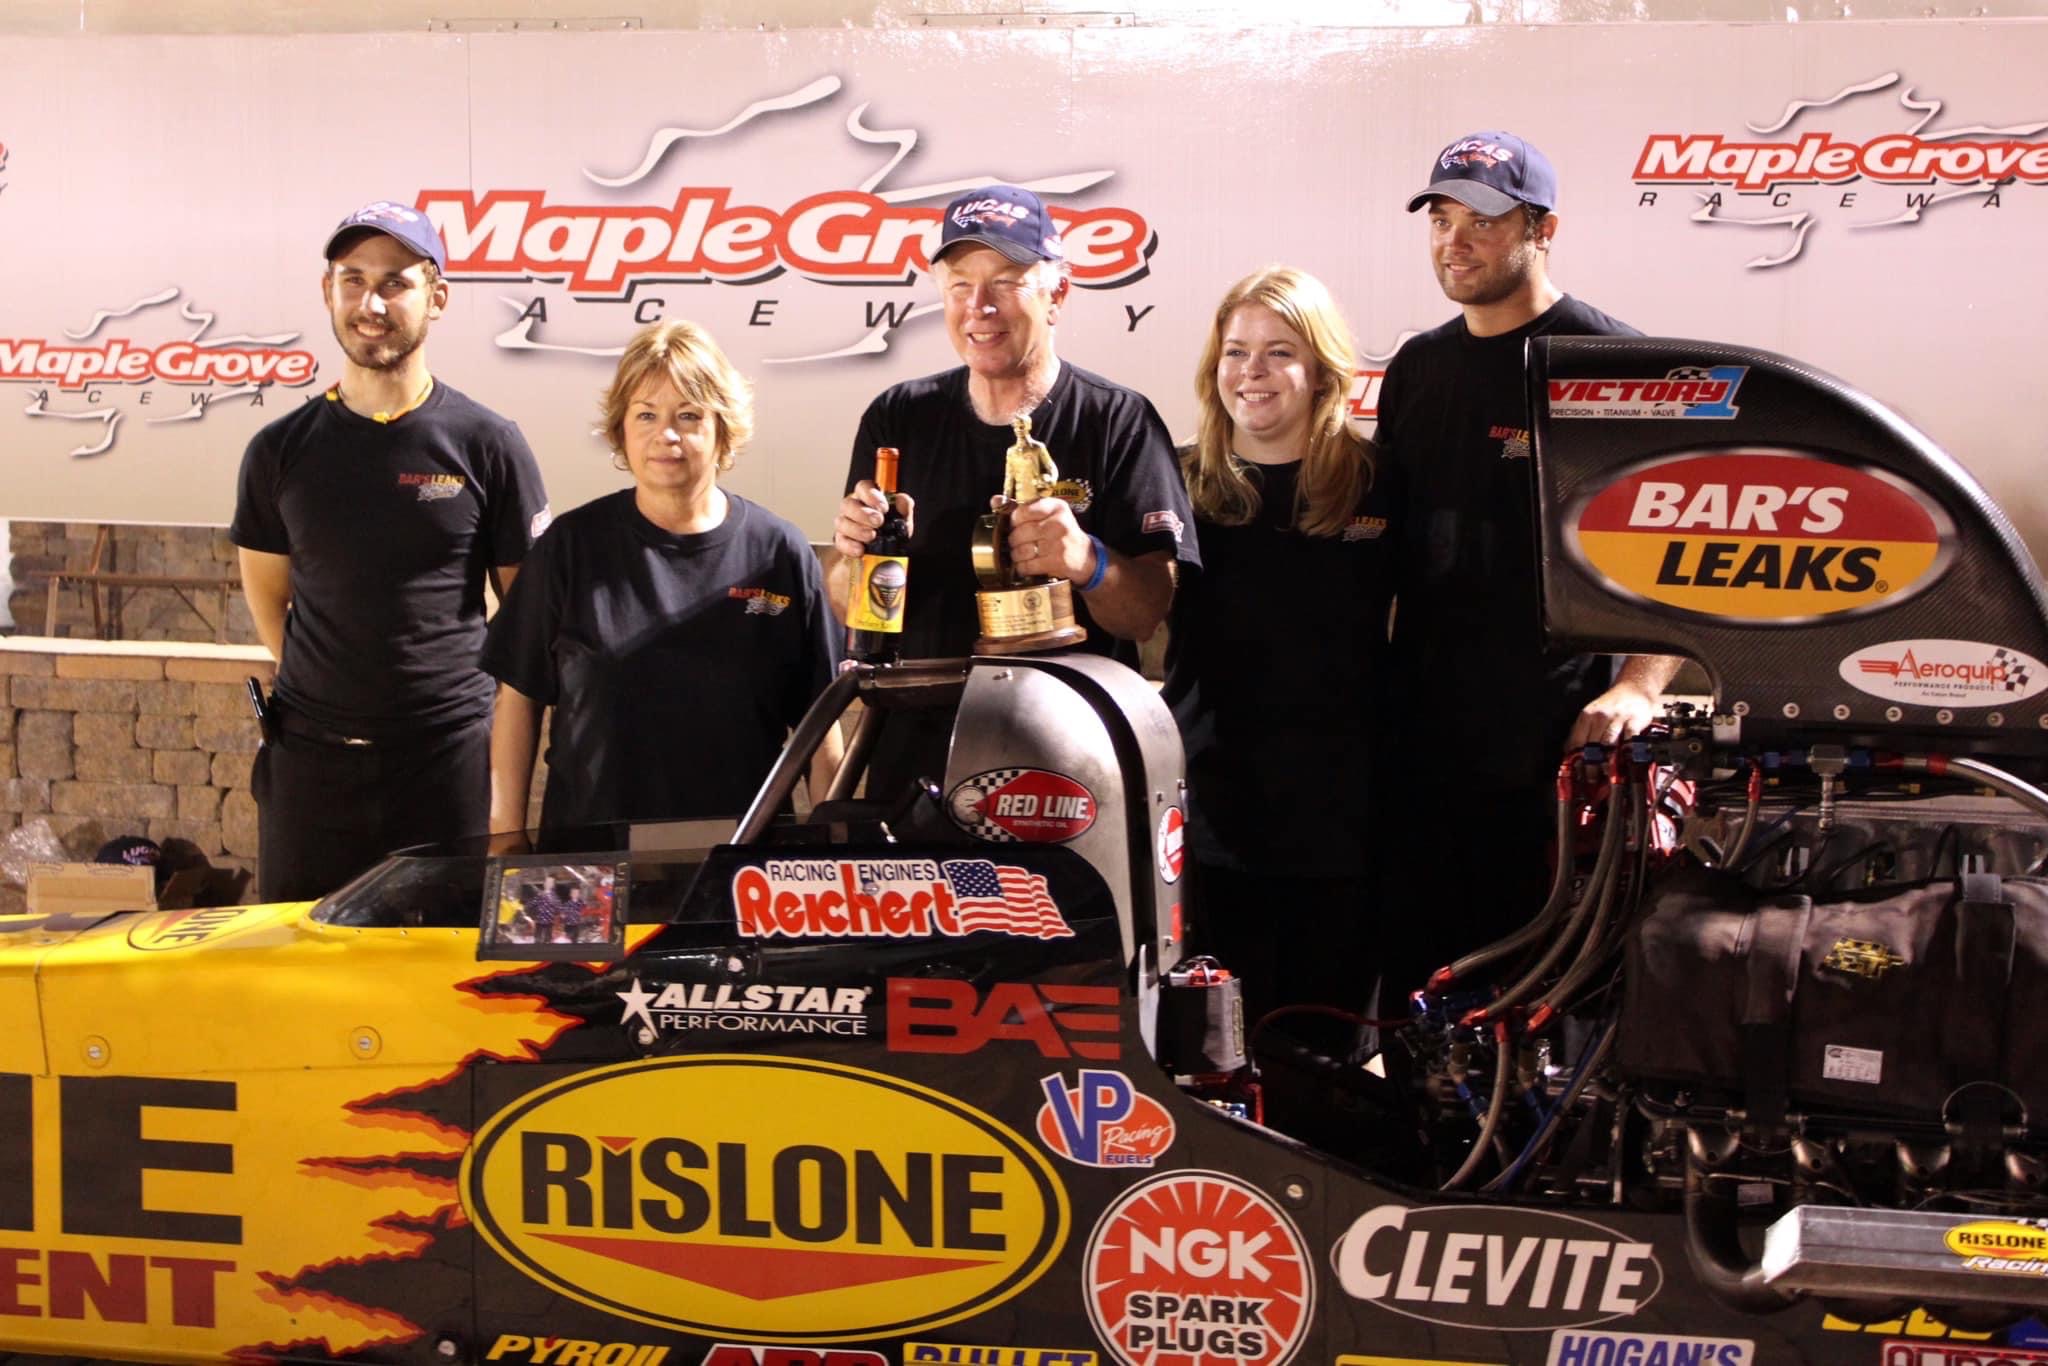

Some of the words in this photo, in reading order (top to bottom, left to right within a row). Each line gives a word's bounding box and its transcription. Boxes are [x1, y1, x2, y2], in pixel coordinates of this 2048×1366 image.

[951, 198, 1030, 220] LUCAS
[786, 200, 1138, 266] Gre
[1549, 381, 1731, 403] VICTORY
[1551, 408, 1594, 417] PRECISION
[1603, 408, 1641, 417] TITANIUM
[1651, 408, 1676, 417] VALVE
[1628, 481, 1849, 533] BAR'S
[1656, 541, 1883, 592] LEAKS
[1898, 648, 2006, 683] Aeroquip
[1893, 681, 1950, 690] PERFORMANCE
[996, 794, 1037, 817] RED
[1043, 796, 1089, 820] LINE
[770, 864, 837, 881] RACING
[859, 864, 936, 881] ENGINES
[736, 863, 960, 934] Reichert
[653, 983, 867, 1013] ALLSTAR
[660, 1014, 868, 1036] PERFORMANCE
[886, 977, 1120, 1059] BAE
[1045, 1071, 1132, 1164] VP
[1104, 1122, 1165, 1154] Racing
[1105, 1153, 1153, 1164] FUELS
[520, 1130, 1007, 1252] RISLONE
[1130, 1226, 1273, 1283] NGK
[1958, 1231, 2047, 1250] RISLONE
[1339, 1205, 1653, 1314] CLEVITE
[1961, 1255, 2048, 1279] Racin
[1129, 1294, 1264, 1326] SPARK
[1130, 1325, 1264, 1357] PLUGS
